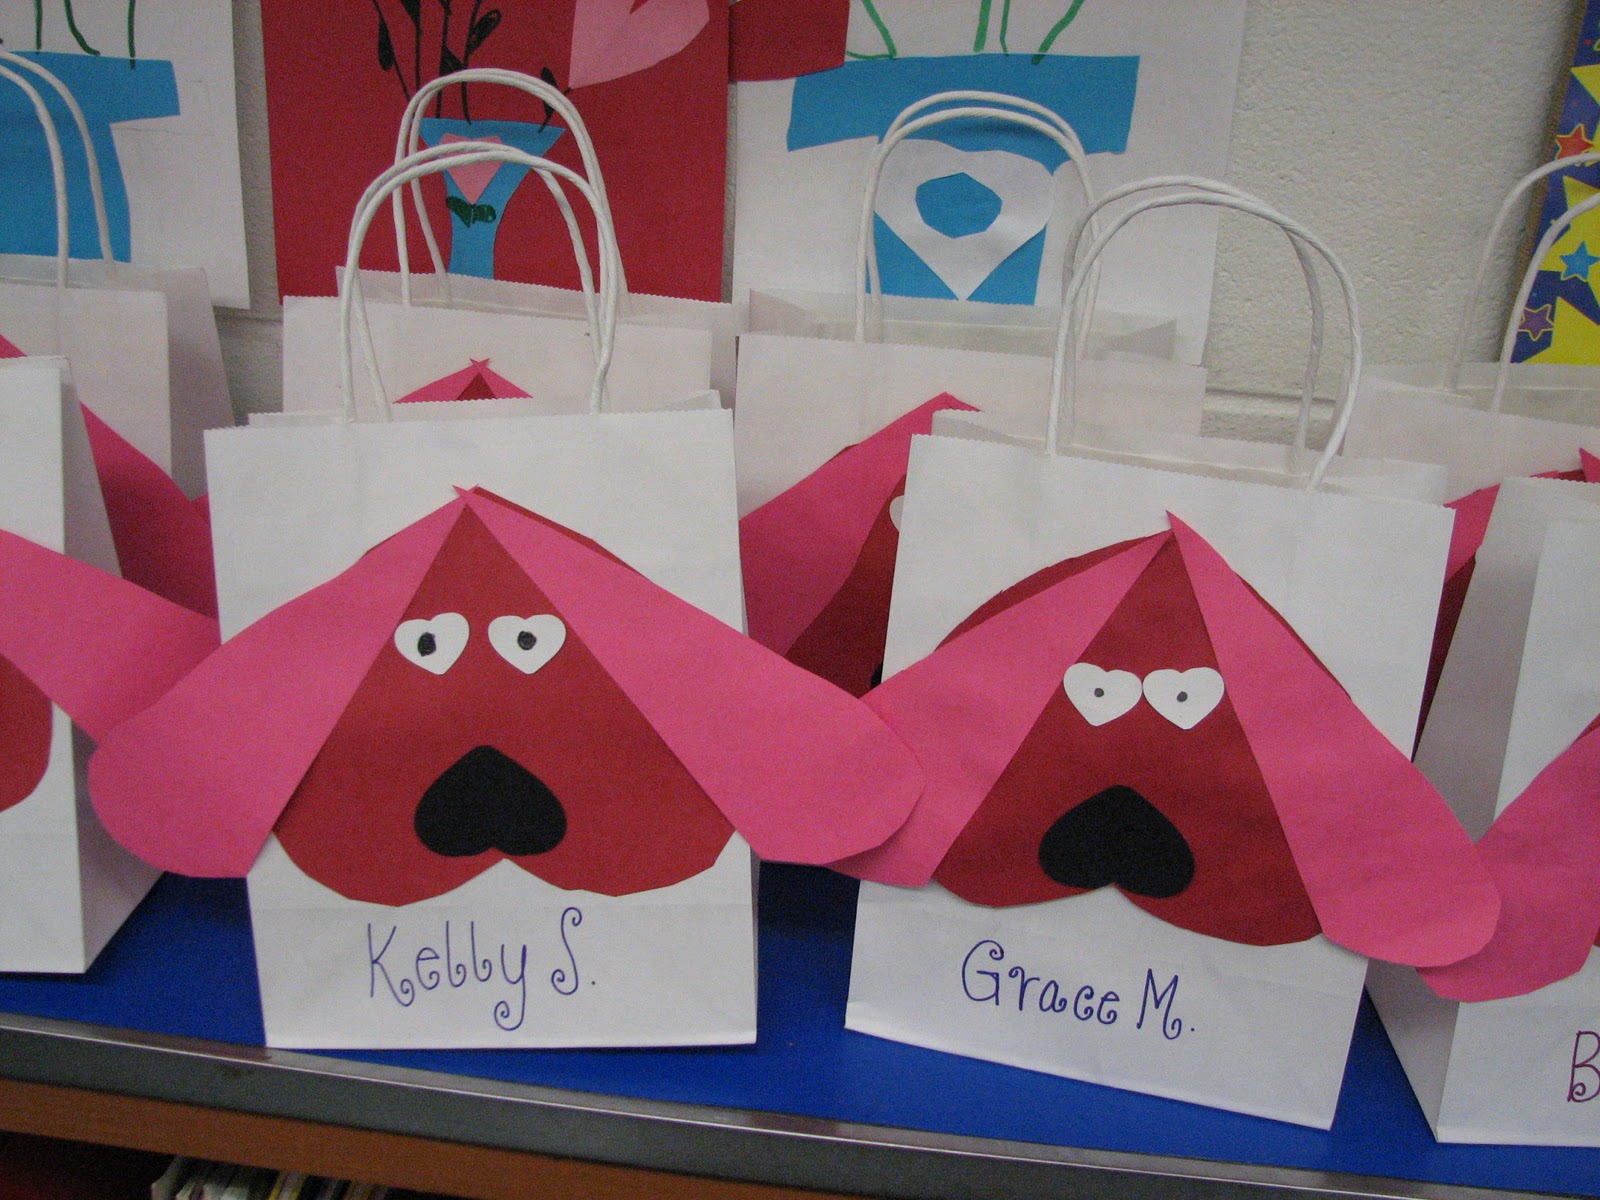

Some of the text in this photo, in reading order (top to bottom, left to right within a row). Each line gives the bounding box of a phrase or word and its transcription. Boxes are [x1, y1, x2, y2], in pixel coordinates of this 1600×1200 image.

[367, 906, 596, 1031] Kelly S.
[961, 939, 1196, 1040] Grace M.
